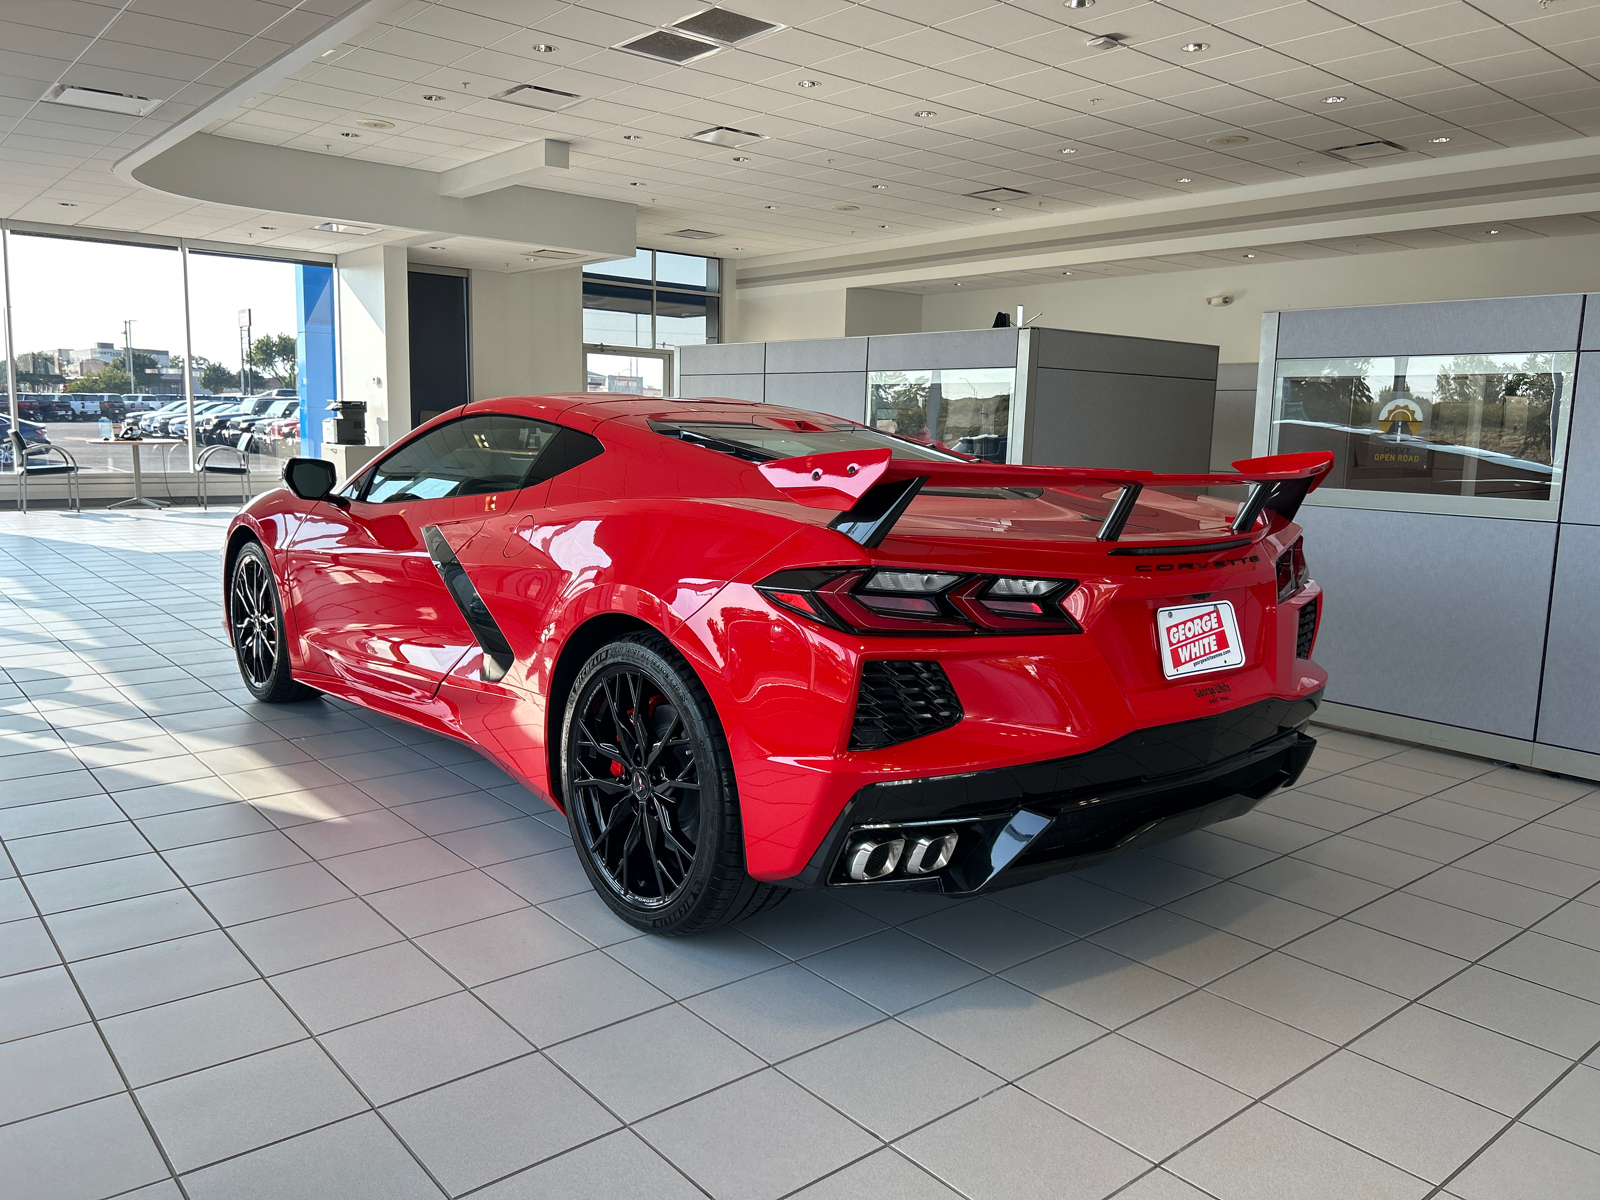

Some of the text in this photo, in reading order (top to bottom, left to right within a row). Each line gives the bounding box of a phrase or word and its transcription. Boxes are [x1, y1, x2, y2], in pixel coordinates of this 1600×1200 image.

[1135, 556, 1260, 572] CORVETTE
[1169, 612, 1219, 644] GEORGE
[1178, 634, 1218, 663] WHITE
[572, 650, 609, 692] MICHELIN
[651, 658, 671, 679] SEASON
[1193, 682, 1232, 698] George White
[654, 892, 695, 929] MICHELIN
